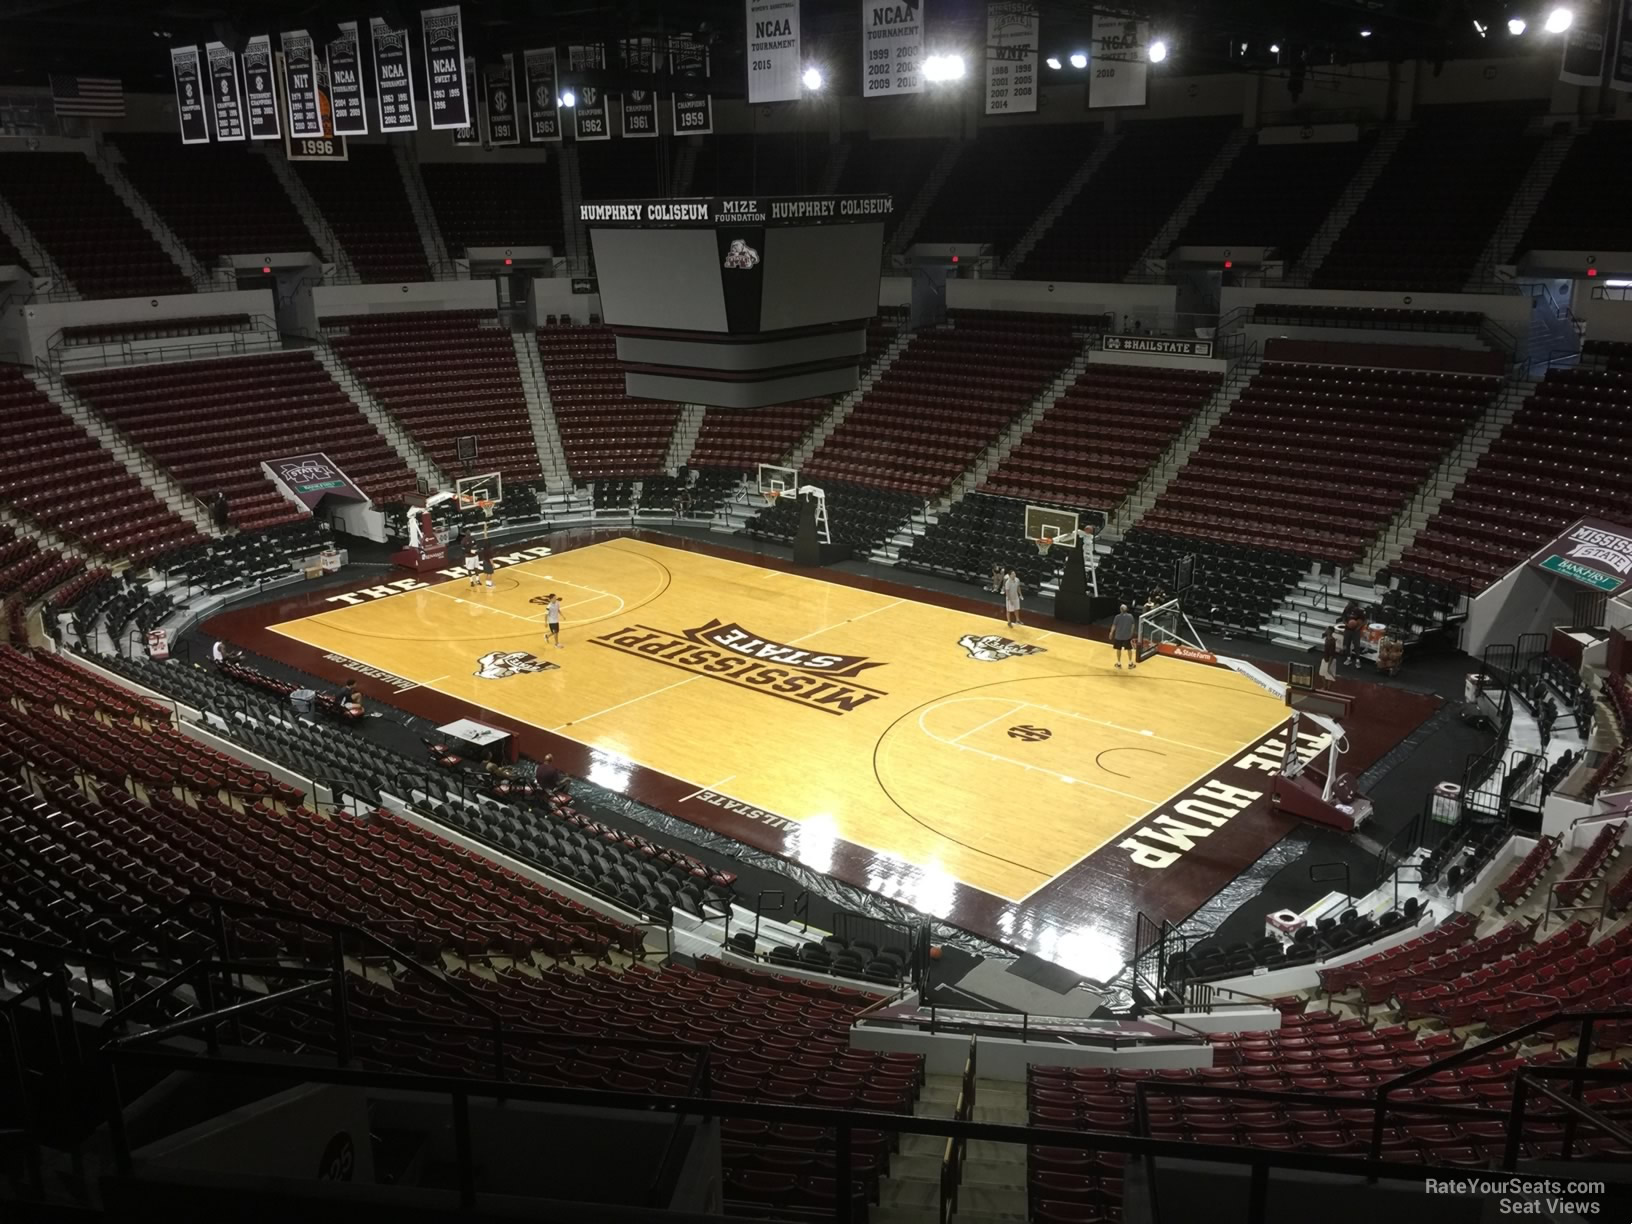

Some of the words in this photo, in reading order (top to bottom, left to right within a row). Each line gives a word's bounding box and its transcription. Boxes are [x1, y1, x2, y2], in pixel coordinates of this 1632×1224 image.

[424, 15, 459, 29] MISSISSIPPI
[873, 5, 914, 26] NCAA
[756, 19, 792, 38] NCAA
[868, 26, 920, 40] TOURNAMENT
[752, 39, 796, 51] TOURNAMENT
[870, 49, 889, 60] 1999
[382, 64, 404, 79] NCAA
[433, 58, 456, 73] NCAA
[753, 60, 772, 71] 2015
[869, 64, 890, 75] 2002
[334, 70, 355, 84] NCAA
[434, 75, 450, 83] SWEET
[1096, 68, 1115, 78] 2010
[294, 74, 308, 88] NIT
[380, 79, 407, 88] TOURNAMENT
[869, 79, 890, 90] 2009
[897, 76, 918, 88] 2010
[992, 78, 1008, 86] 2001
[1014, 76, 1032, 85] 2005
[433, 90, 445, 98] 1963
[991, 90, 1008, 98] 2007
[1014, 87, 1032, 96] 2008
[434, 101, 446, 110] 1996
[677, 100, 706, 109] CHAMPIONS
[991, 100, 1008, 109] 2014
[582, 120, 602, 132] 1962
[630, 116, 648, 129] 1961
[681, 112, 704, 127] 1959
[457, 128, 475, 138] 2004
[494, 125, 511, 137] 1991
[536, 121, 554, 134] 1963
[301, 140, 333, 154] 1996
[580, 205, 643, 221] HUMPHREY
[648, 204, 708, 220] COLISEUM
[723, 201, 757, 213] MIZE
[772, 200, 835, 218] HUMPHREY
[840, 199, 894, 215] COLISEUM
[715, 213, 766, 222] FOUNDATION
[1124, 340, 1190, 352] #HAILSTATE
[1581, 548, 1626, 567] STATE
[326, 578, 430, 604] THE
[436, 546, 552, 579] HMP
[713, 628, 843, 668] STATE
[596, 627, 880, 712] MISSISSIPPI
[1233, 728, 1332, 776] THE
[696, 792, 802, 831] AILSTATE
[1116, 779, 1264, 869] HUMP
